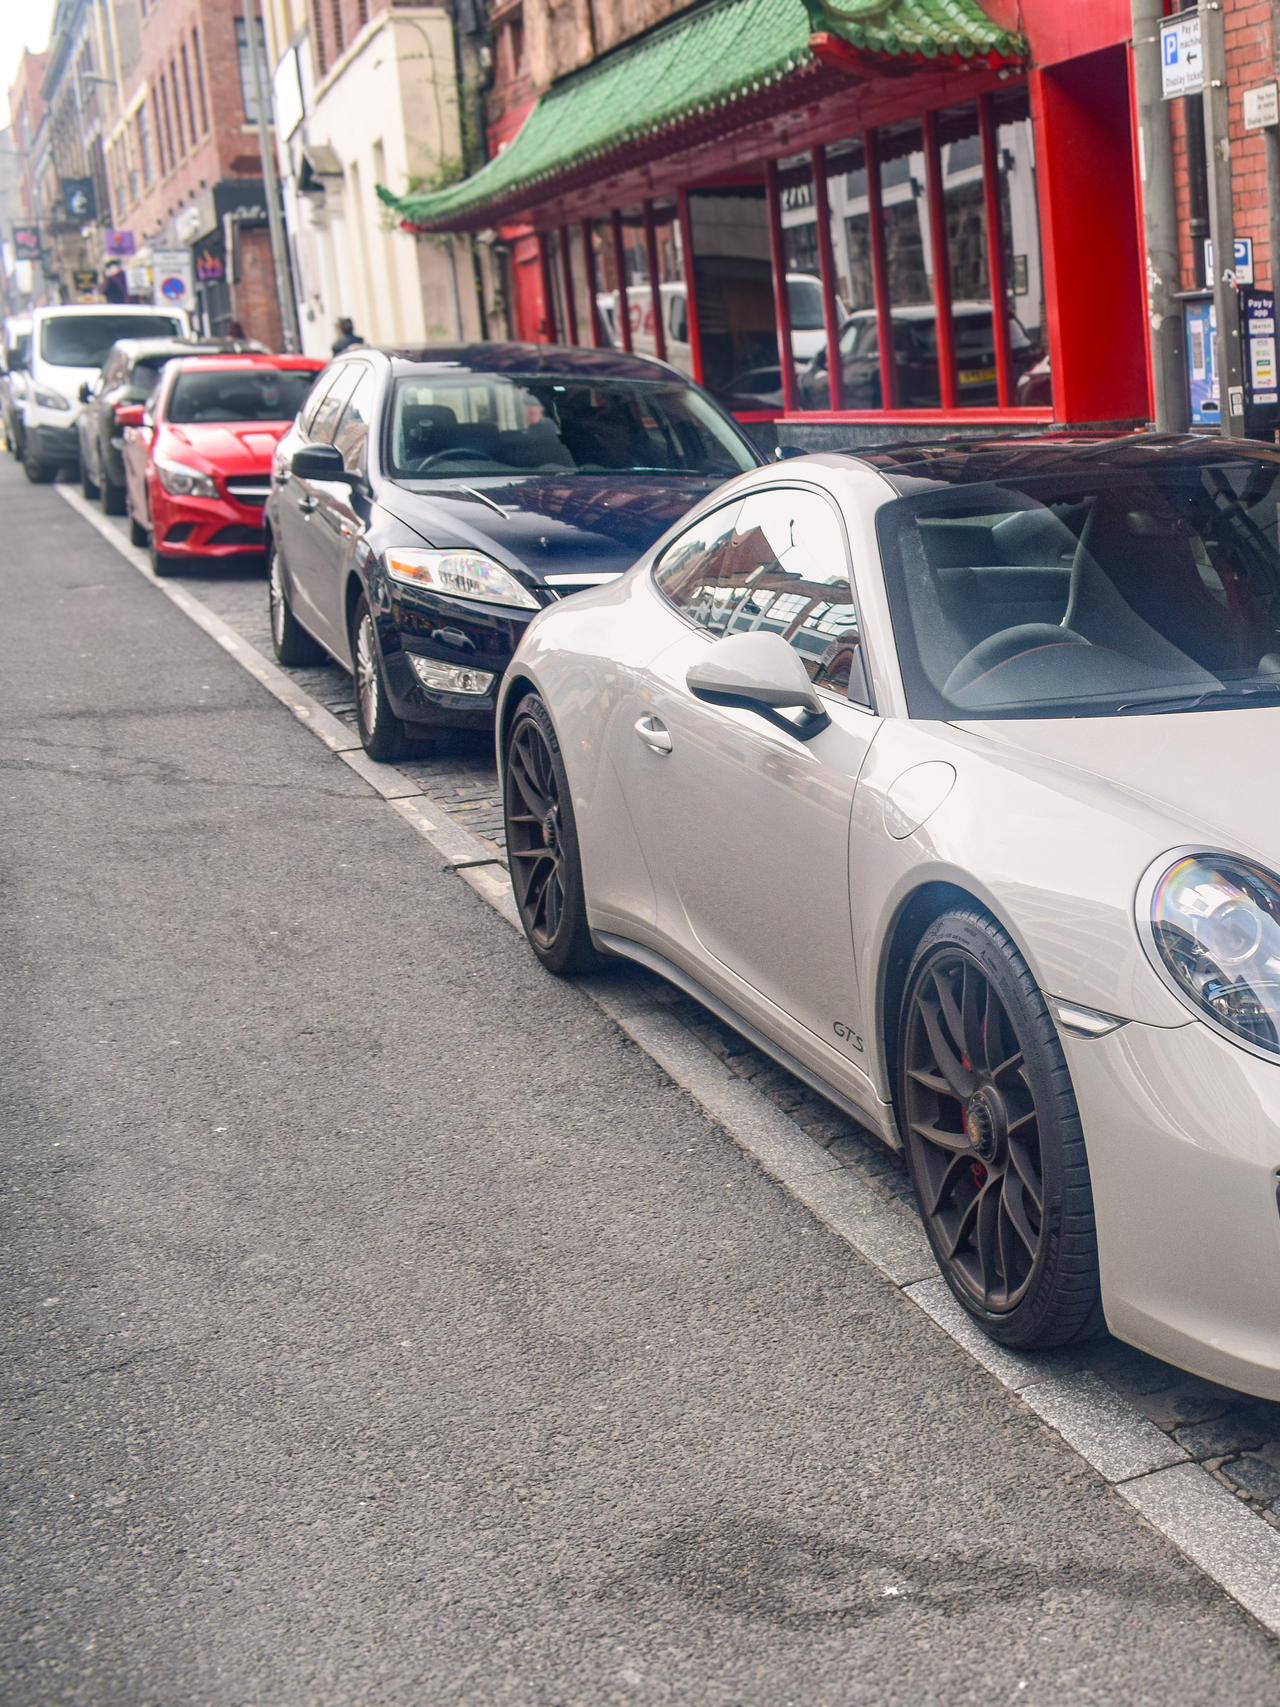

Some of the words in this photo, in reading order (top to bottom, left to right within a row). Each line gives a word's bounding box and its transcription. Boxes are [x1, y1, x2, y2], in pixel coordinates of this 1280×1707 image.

[1181, 24, 1191, 35] Pay
[1193, 22, 1199, 32] at
[1165, 74, 1185, 88] Display
[1247, 299, 1262, 309] Pay
[1263, 298, 1273, 309] by
[1253, 309, 1268, 318] app
[833, 1021, 864, 1053] GTS
